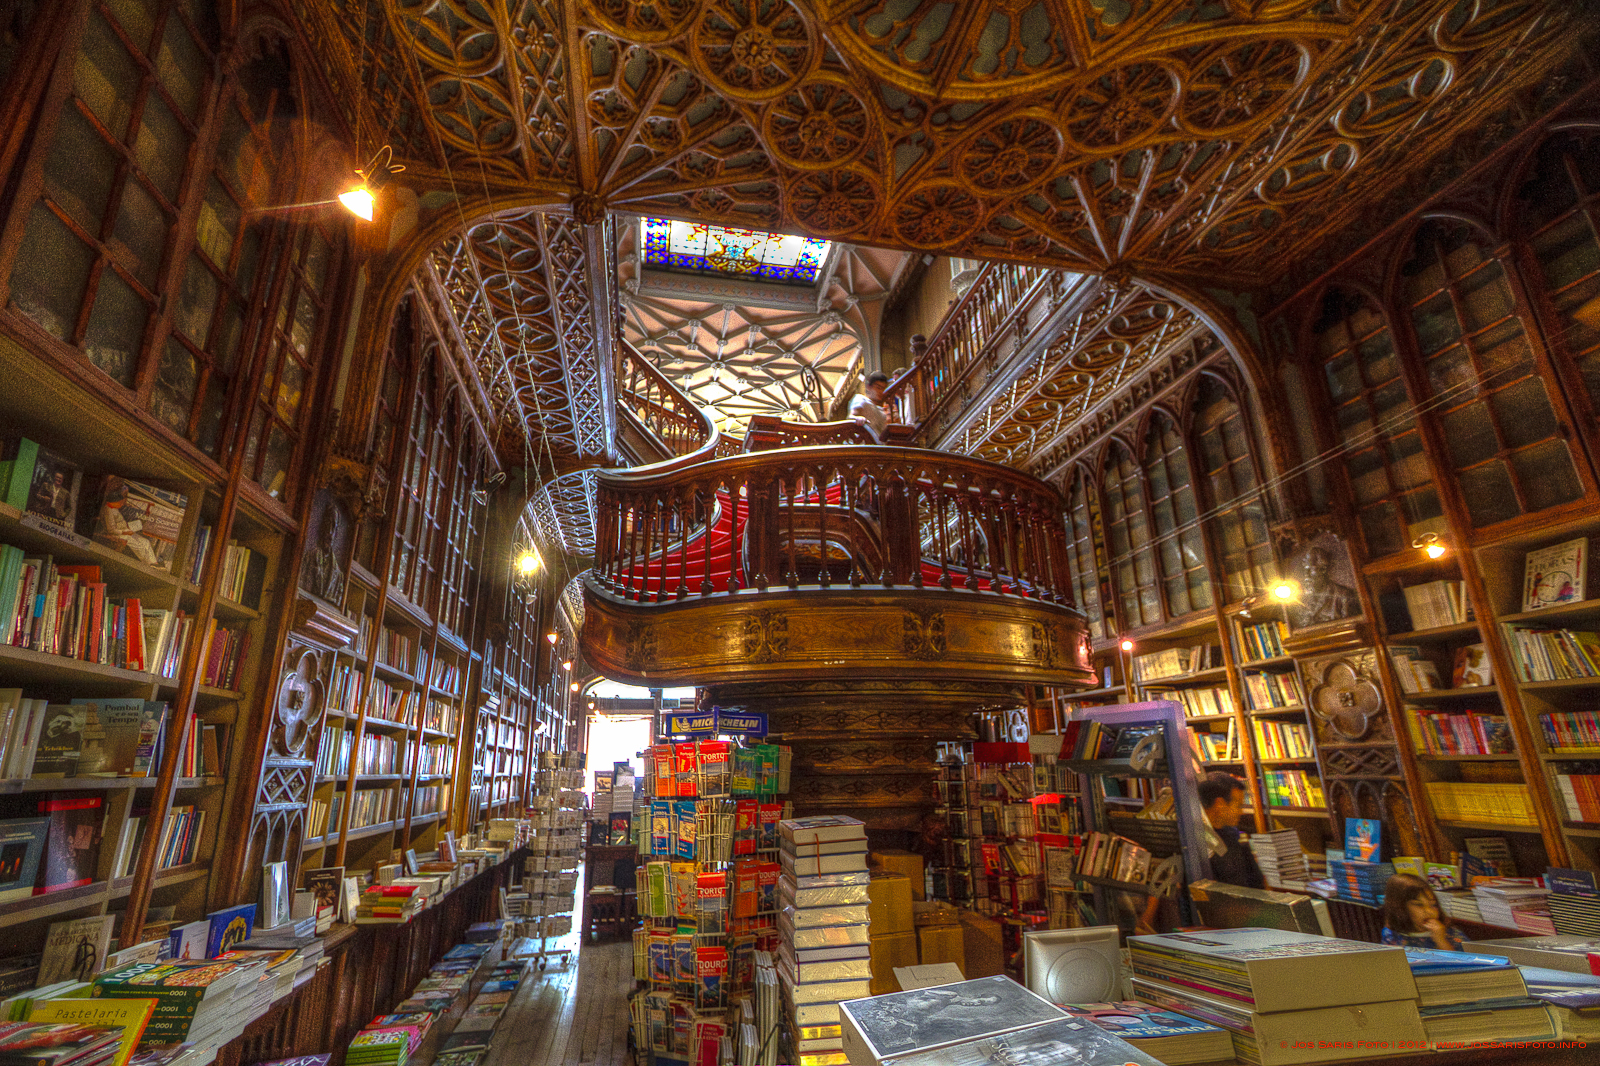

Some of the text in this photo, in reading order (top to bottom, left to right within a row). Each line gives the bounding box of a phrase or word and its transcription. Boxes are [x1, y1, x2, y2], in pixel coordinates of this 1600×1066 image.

[39, 521, 75, 542] BIOGRAFIAS
[104, 704, 139, 712] Pombal
[107, 716, 138, 724] Tempo
[699, 960, 727, 969] DOURO
[104, 963, 156, 983] 1000
[55, 1008, 128, 1019] Pastelaria
